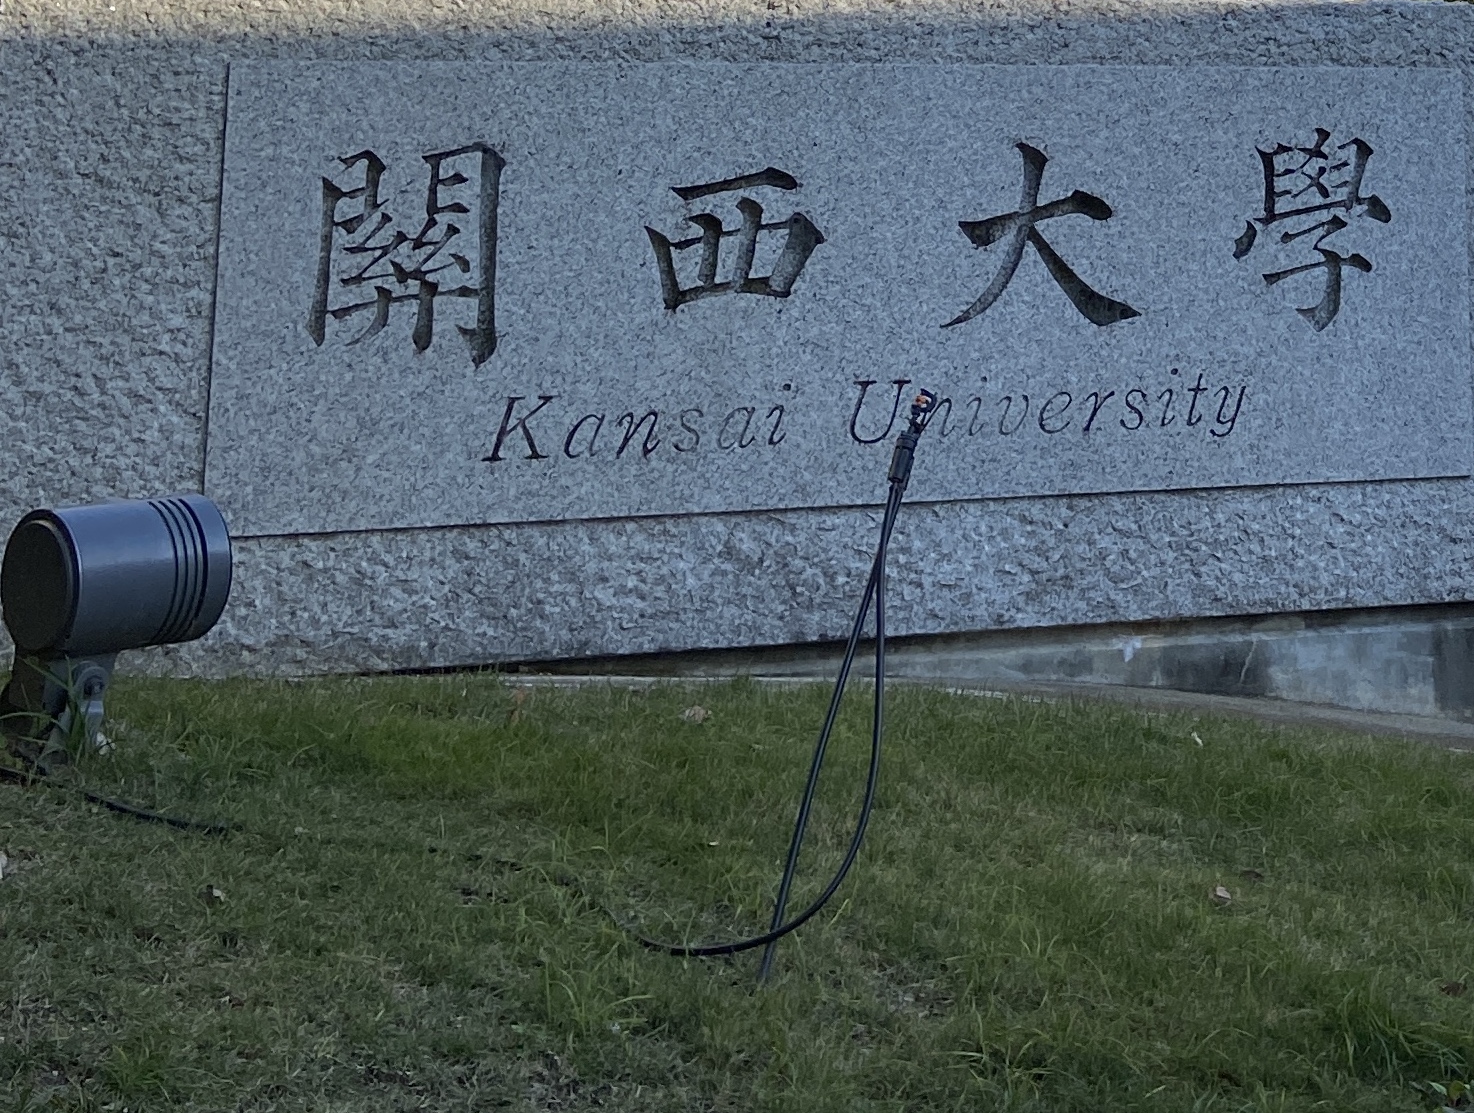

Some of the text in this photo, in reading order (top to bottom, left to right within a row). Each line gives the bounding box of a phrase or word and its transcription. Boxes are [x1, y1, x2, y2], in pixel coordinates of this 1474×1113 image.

[304, 126, 1391, 366] 關西大學
[482, 367, 1248, 462] Kansai University
